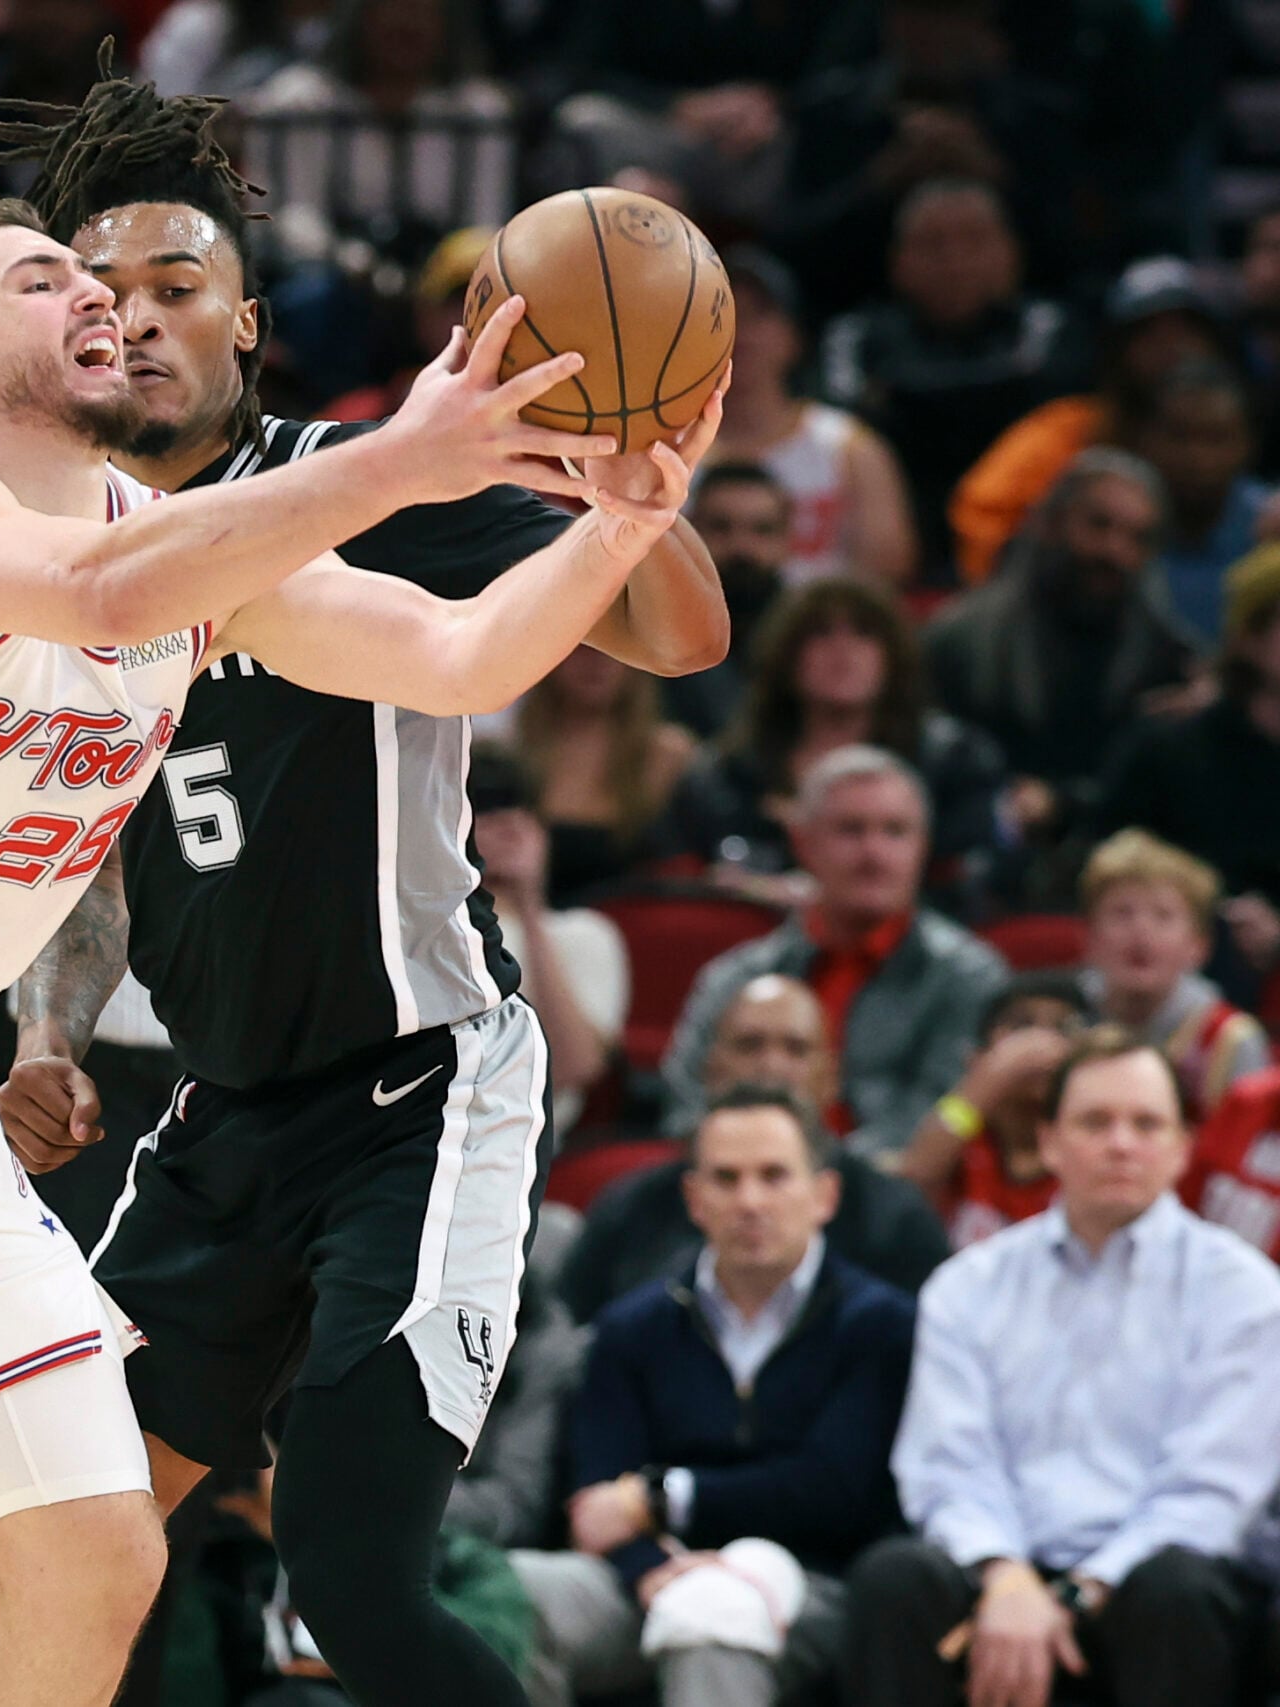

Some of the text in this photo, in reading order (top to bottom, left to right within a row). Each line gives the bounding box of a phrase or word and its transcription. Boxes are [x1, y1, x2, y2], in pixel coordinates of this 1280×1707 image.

[117, 631, 188, 661] EMORIAL
[121, 639, 189, 671] ERMANN
[160, 741, 246, 873] 5
